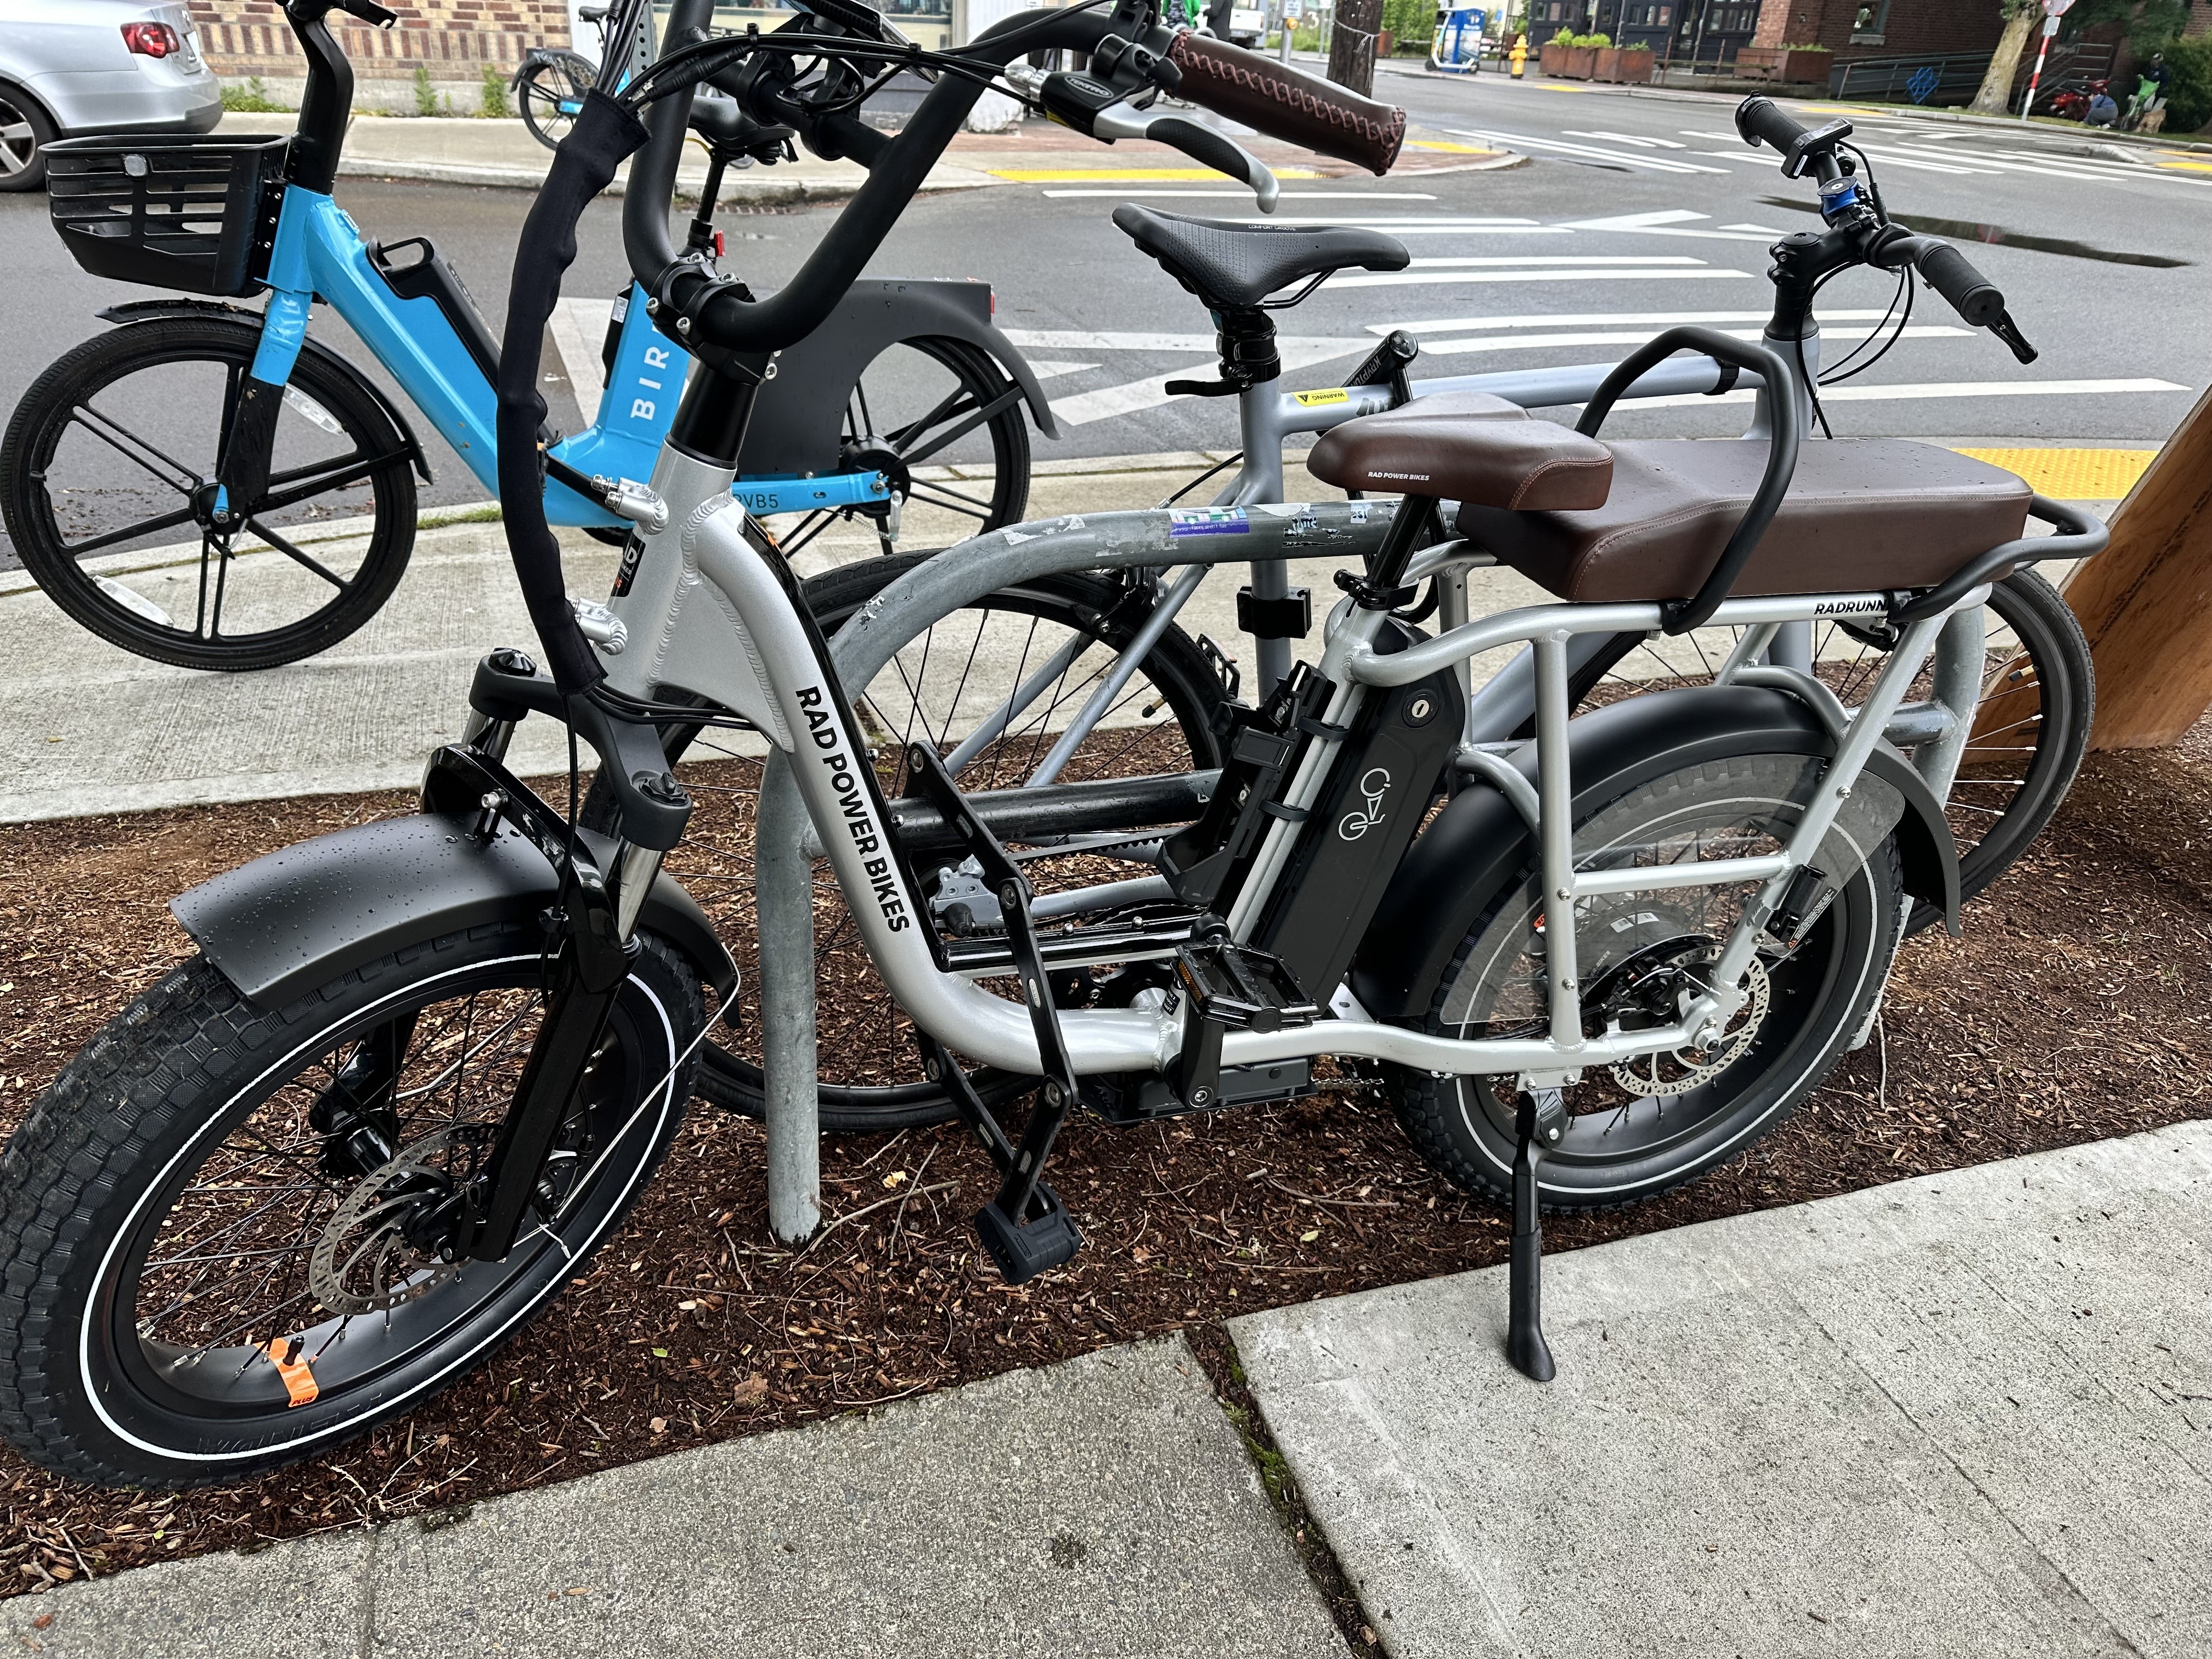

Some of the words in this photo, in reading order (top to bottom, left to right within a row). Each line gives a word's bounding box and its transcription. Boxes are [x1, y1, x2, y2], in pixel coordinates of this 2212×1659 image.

[630, 323, 670, 421] BIR
[1312, 392, 1345, 400] WARNING
[795, 686, 837, 749] RAD
[822, 753, 879, 855] POWER
[864, 856, 910, 932] BIKES
[291, 1396, 314, 1406] PLUS
